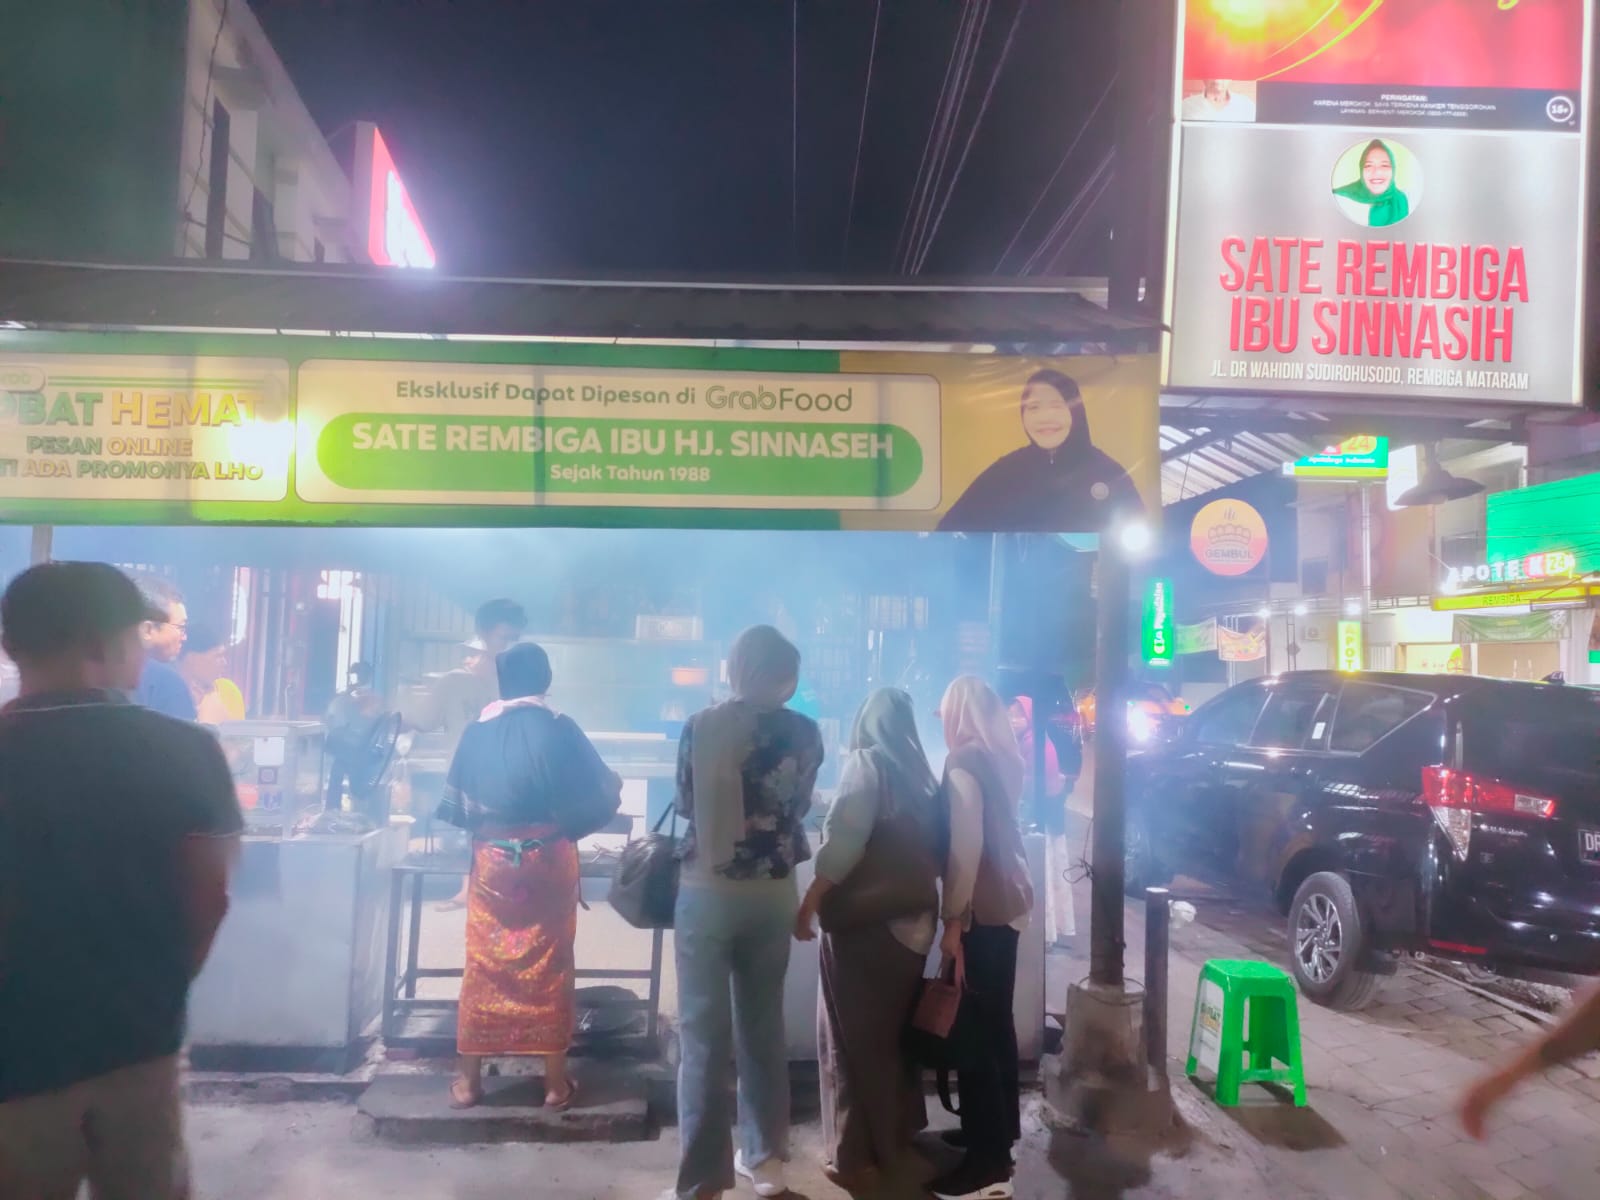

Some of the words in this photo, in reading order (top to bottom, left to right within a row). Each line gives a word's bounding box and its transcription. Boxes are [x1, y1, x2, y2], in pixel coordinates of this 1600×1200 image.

[1219, 235, 1324, 294] SATE
[1336, 239, 1530, 303] REMBIGA
[1229, 295, 1300, 354] IBU
[1311, 299, 1514, 364] SINNASIH
[1210, 360, 1227, 377] JL.
[1230, 362, 1248, 378] DR
[1249, 362, 1304, 381] WAHIDIN
[1407, 368, 1464, 387] REMBIGA
[1466, 370, 1529, 390] MATARAM
[112, 391, 264, 428] HEMAT
[397, 380, 500, 400] Eksklusif
[505, 383, 575, 406] Dapat
[581, 384, 671, 408] Dipesan
[675, 385, 696, 405] di
[705, 384, 853, 413] GrabFood
[26, 435, 103, 455] PESAN
[107, 437, 193, 457] ONLINE
[352, 422, 437, 451] SATE
[446, 423, 603, 454] REMBIGA
[611, 427, 666, 456] IBU
[674, 429, 723, 457] HJ.
[730, 429, 893, 459] SINNASEH
[22, 459, 73, 478] ADA
[77, 460, 210, 480] PROMONYA
[215, 462, 263, 480] LHO
[550, 463, 603, 484] Sejak
[606, 464, 666, 480] Tahun
[669, 466, 710, 481] 1988
[1205, 549, 1254, 560] GEMBUL
[1549, 555, 1566, 572] 24
